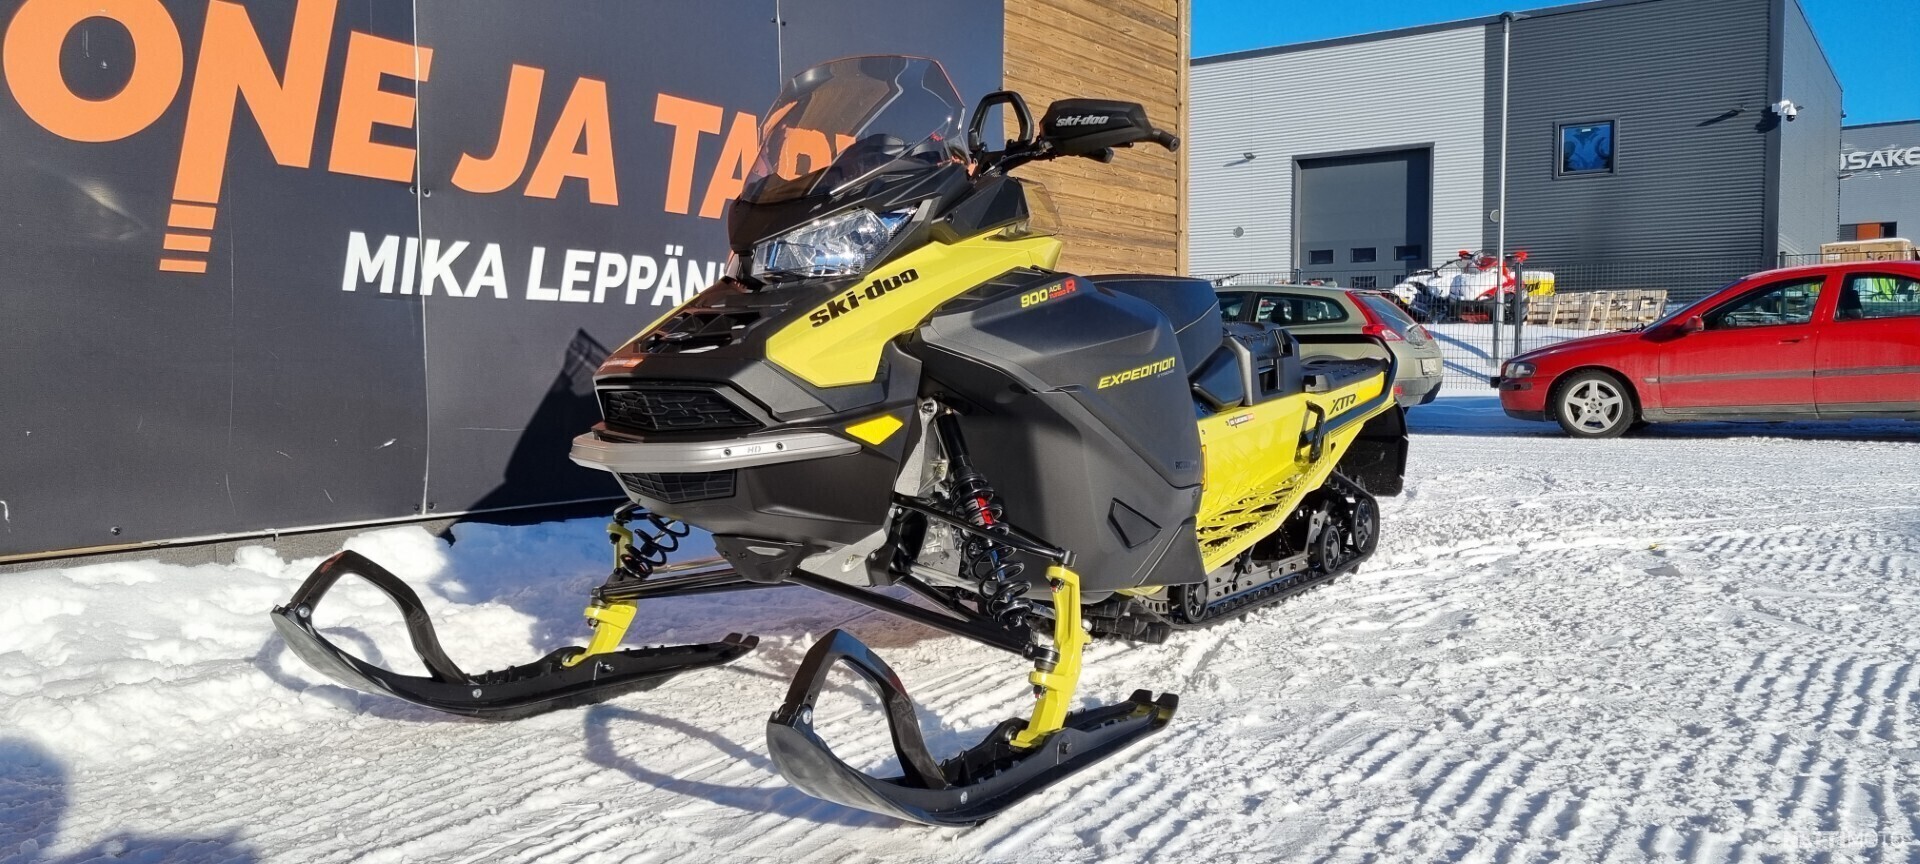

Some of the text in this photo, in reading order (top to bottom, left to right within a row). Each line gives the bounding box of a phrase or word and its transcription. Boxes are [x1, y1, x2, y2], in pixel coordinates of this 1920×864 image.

[451, 63, 619, 207] JA
[1056, 114, 1110, 127] ski-doo
[341, 230, 725, 307] MIKA LEPPÄN
[808, 268, 919, 328] ski-doo
[1021, 288, 1048, 308] 900
[1049, 283, 1062, 293] ACE
[1097, 356, 1176, 390] EXPEDITION
[1329, 393, 1357, 415] XTR
[747, 445, 762, 454] HD
